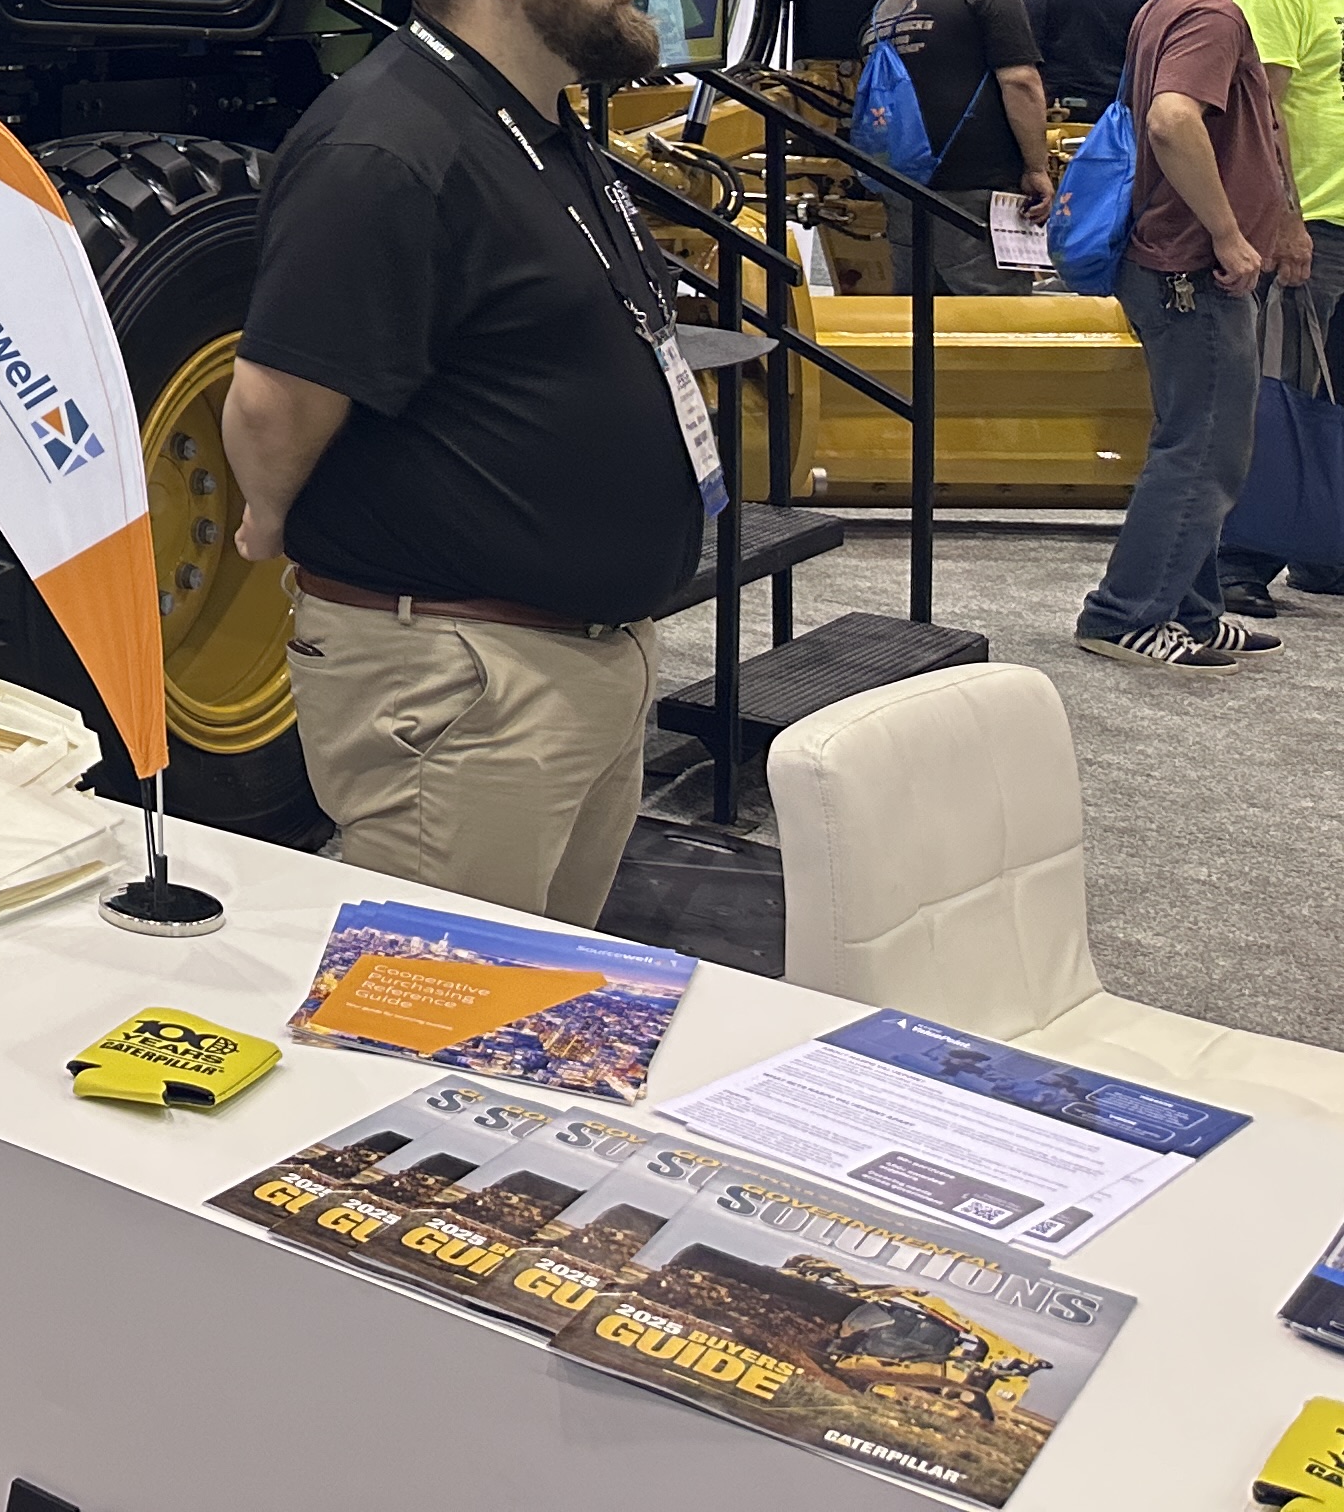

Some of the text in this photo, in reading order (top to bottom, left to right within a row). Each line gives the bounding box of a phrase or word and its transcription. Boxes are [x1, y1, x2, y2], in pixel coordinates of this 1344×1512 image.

[361, 980, 457, 1009] Reference
[368, 972, 476, 1005] Purchasing
[374, 964, 491, 996] Cooperative
[355, 989, 413, 1009] Guide
[99, 1041, 220, 1076] CATERPILLAR
[123, 1032, 224, 1065] YEARS
[342, 1198, 402, 1226] 2025
[741, 1183, 1002, 1272] GOVERNMENTAL
[425, 1217, 488, 1246] 2025
[716, 1184, 1100, 1326] SOLUTIONS
[535, 1257, 601, 1288] 2025
[614, 1302, 804, 1376] 2025 BUYERS'
[594, 1314, 795, 1401] GUIDE
[823, 1429, 965, 1484] CATERPILLAR
